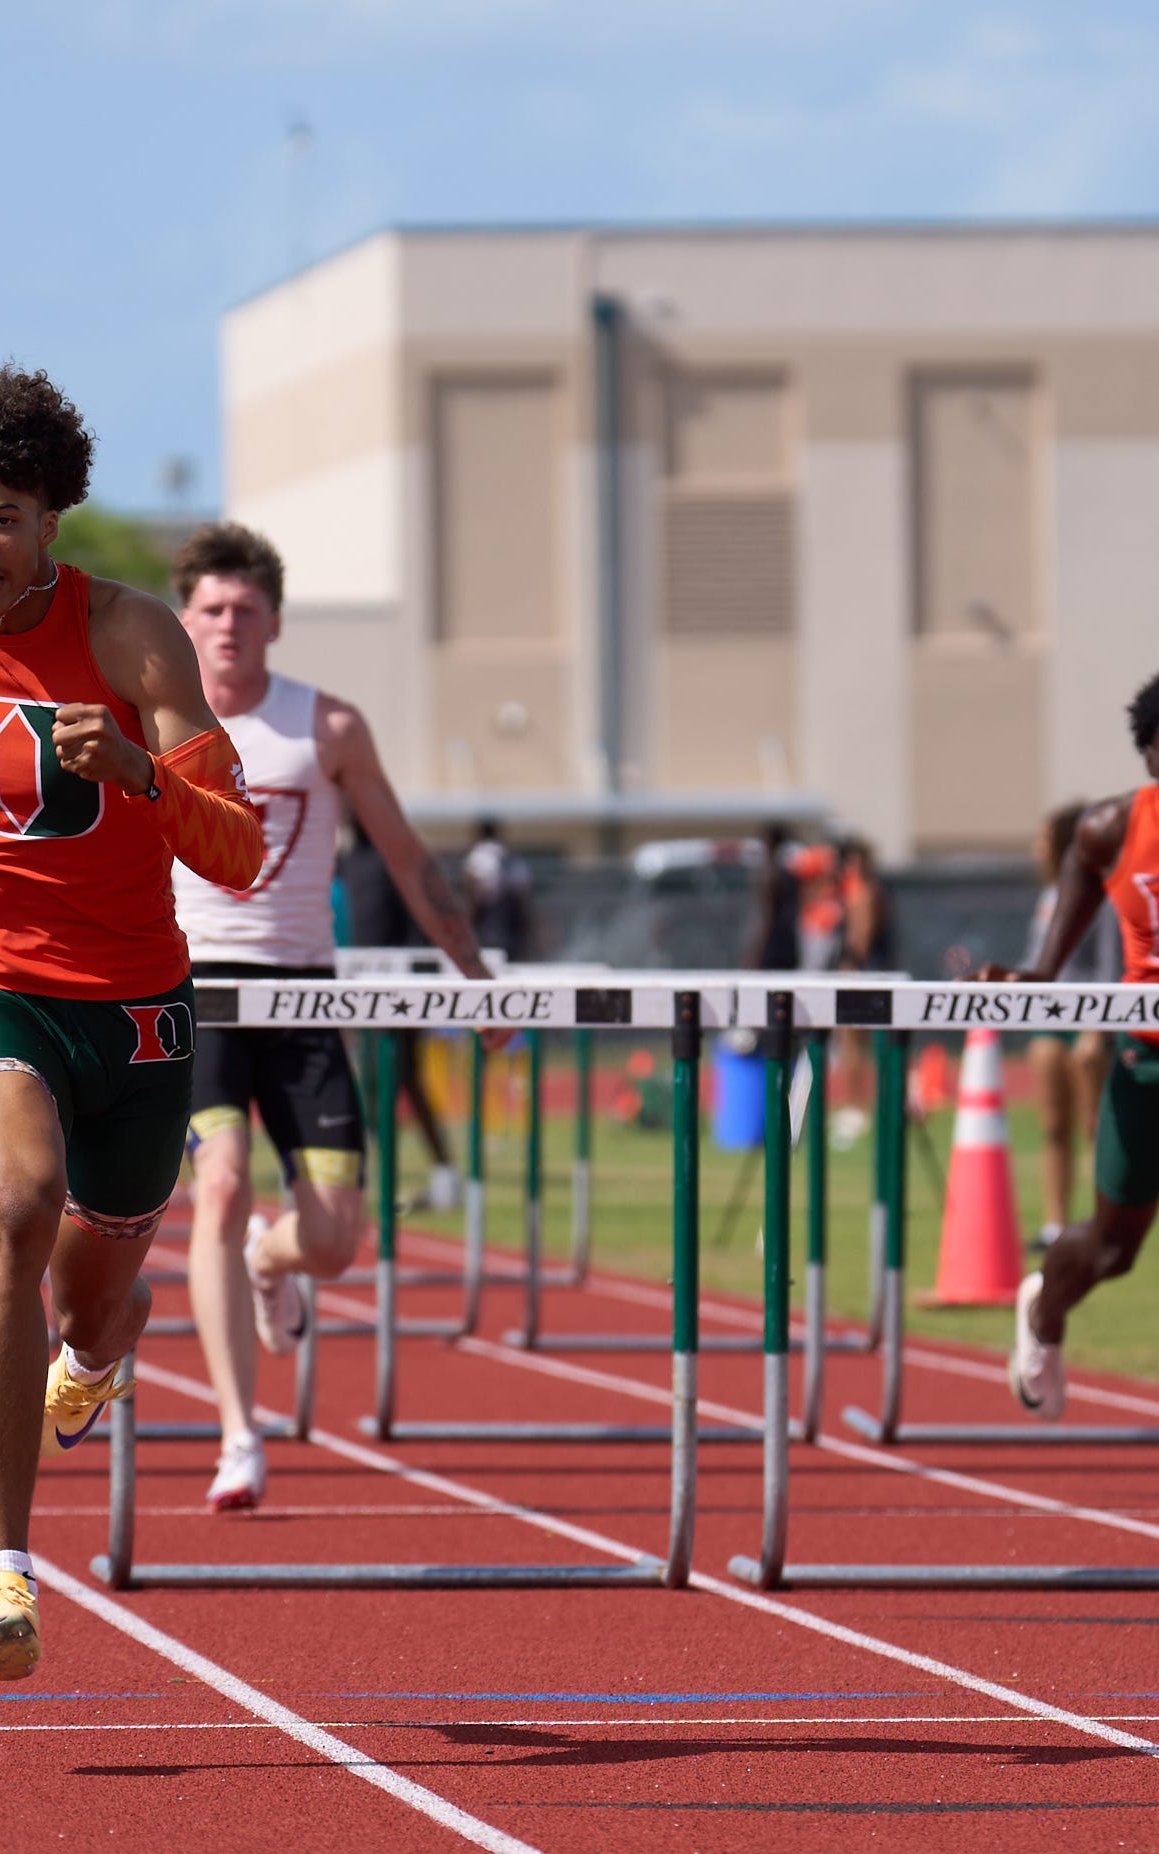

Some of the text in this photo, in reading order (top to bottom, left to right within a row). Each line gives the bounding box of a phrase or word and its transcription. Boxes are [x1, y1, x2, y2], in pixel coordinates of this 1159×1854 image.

[268, 990, 554, 1019] FIRST PLACE
[921, 992, 1159, 1022] FIRST PLA
